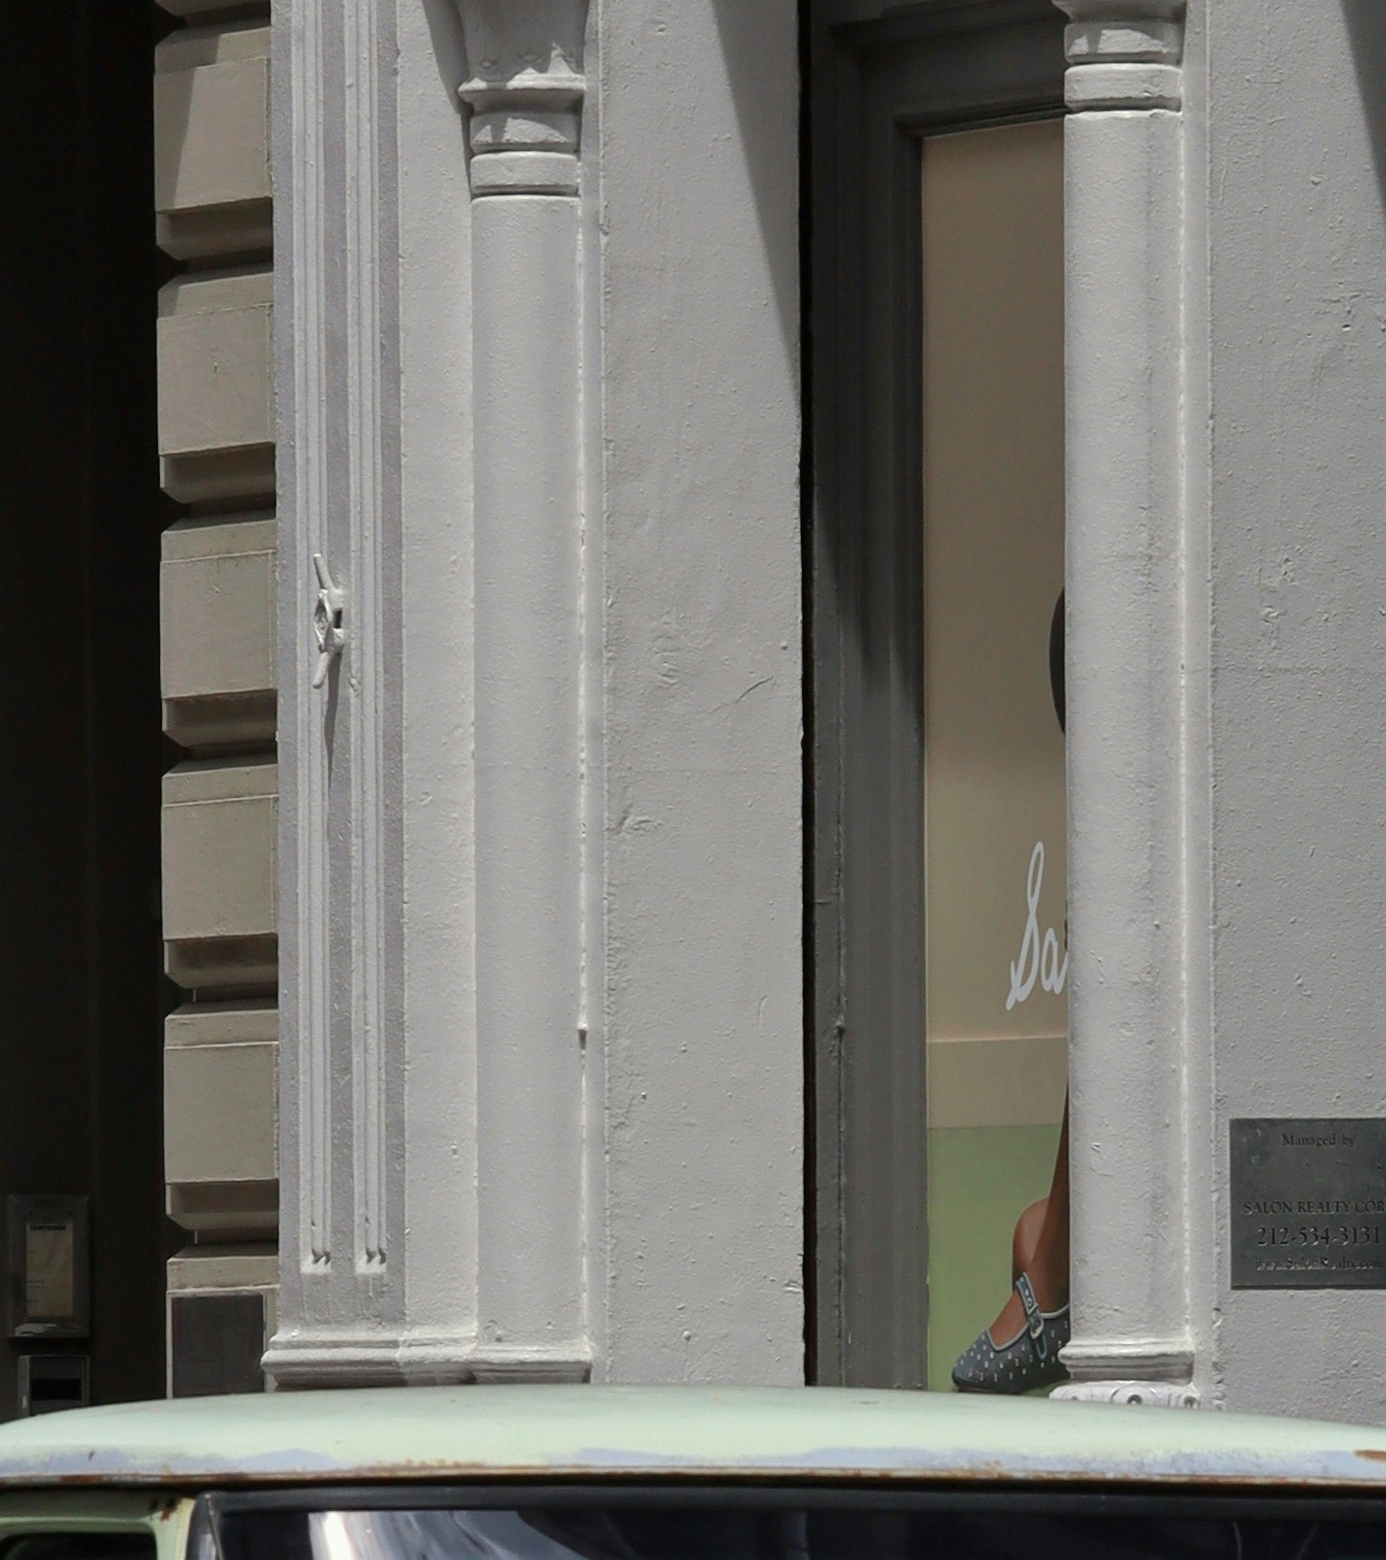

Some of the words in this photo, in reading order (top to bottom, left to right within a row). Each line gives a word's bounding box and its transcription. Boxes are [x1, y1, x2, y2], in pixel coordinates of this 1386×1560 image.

[1005, 841, 1067, 1011] Sa
[1282, 1133, 1336, 1146] Managed
[1342, 1133, 1355, 1148] by
[1244, 1200, 1293, 1215] SALON
[1297, 1200, 1351, 1214] REALTY
[1256, 1225, 1381, 1247] 212-534-3131
